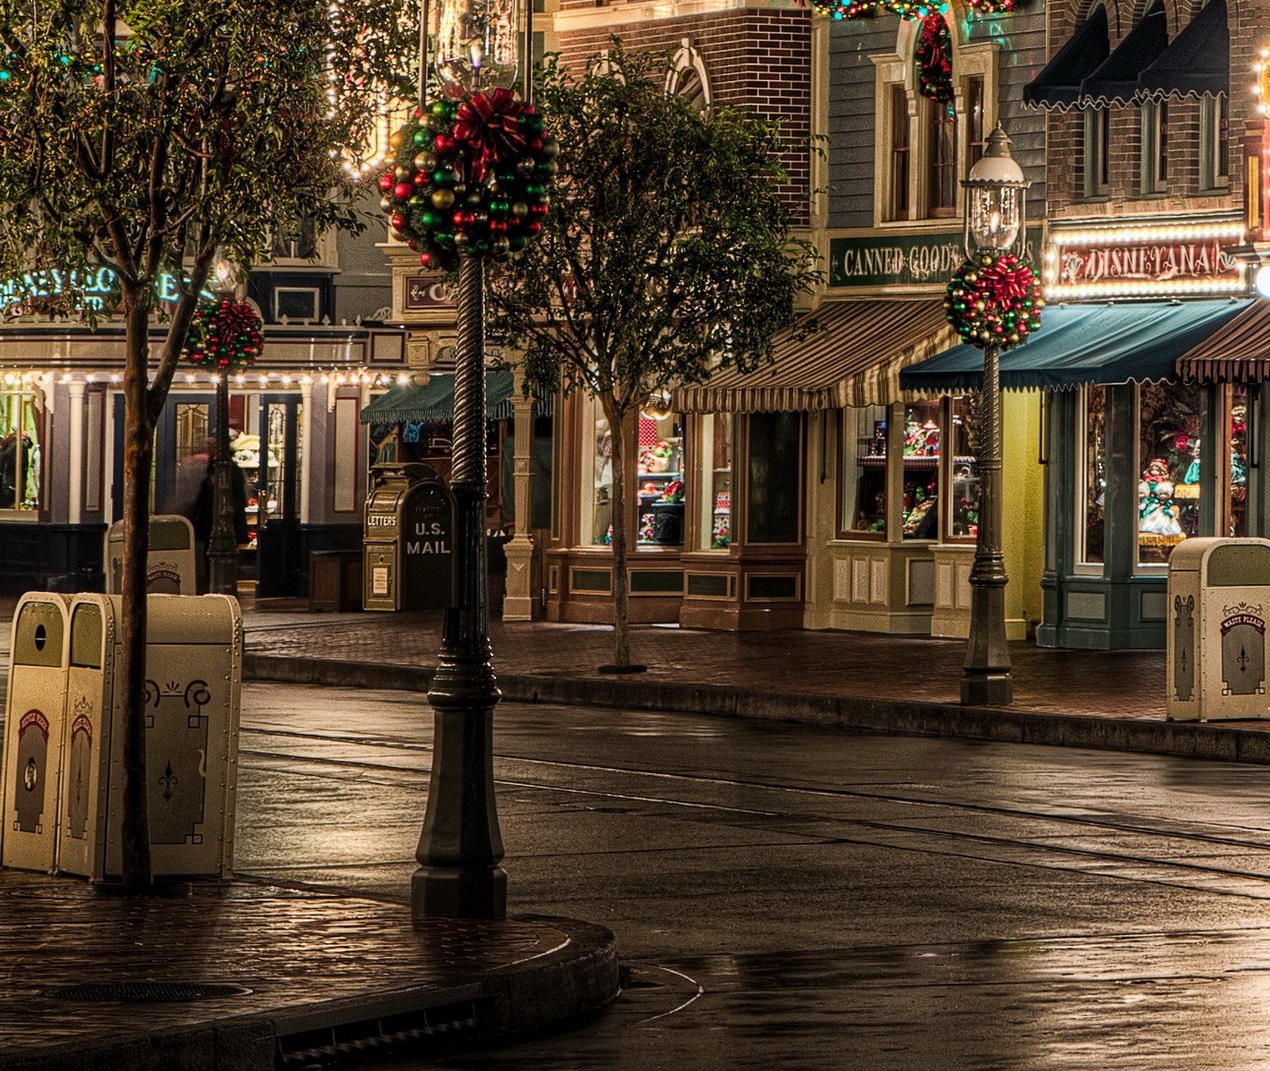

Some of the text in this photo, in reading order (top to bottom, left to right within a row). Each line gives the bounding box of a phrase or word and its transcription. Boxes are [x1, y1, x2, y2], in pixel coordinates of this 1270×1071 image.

[844, 244, 960, 277] CANNED GOODS
[1085, 243, 1213, 282] DISNEYANA
[367, 515, 397, 527] LETTERS
[415, 522, 446, 536] U.S.
[406, 540, 452, 555] MAIL
